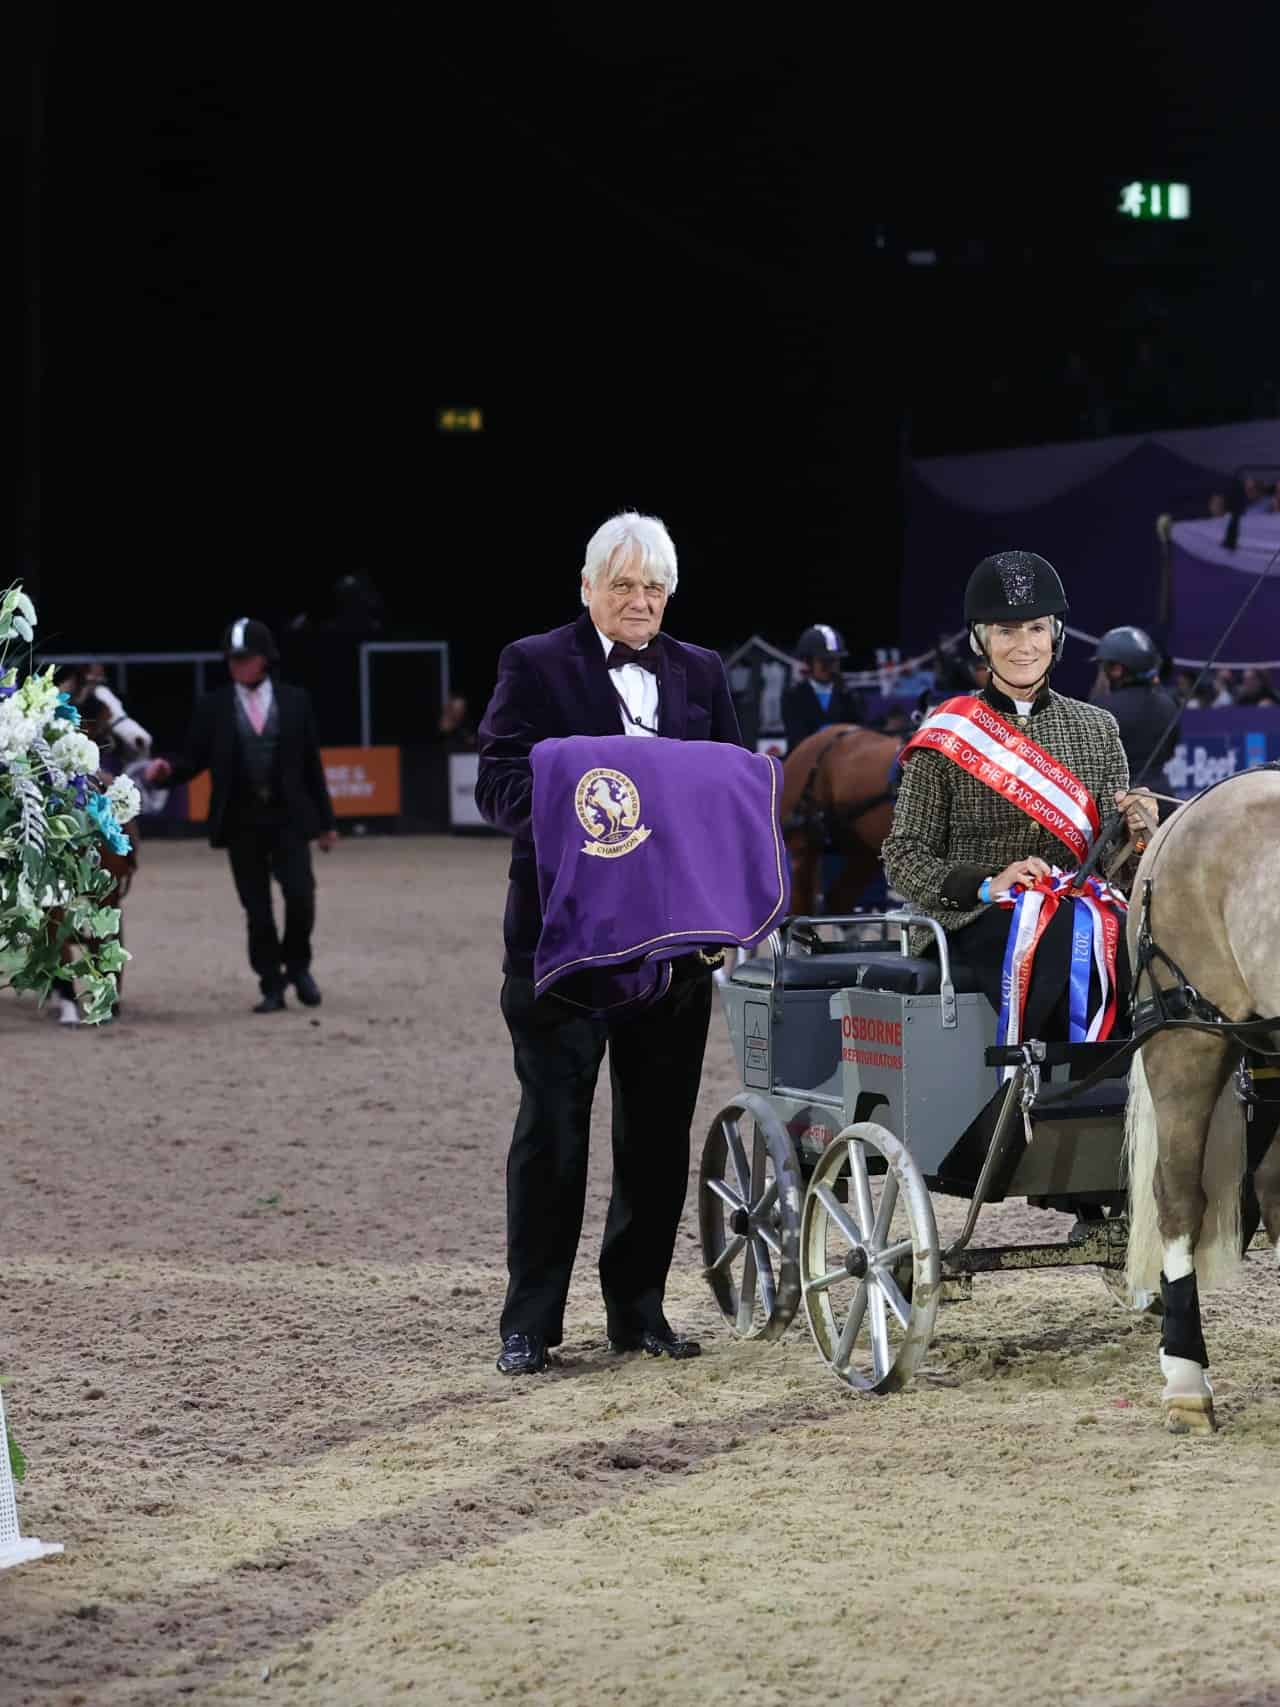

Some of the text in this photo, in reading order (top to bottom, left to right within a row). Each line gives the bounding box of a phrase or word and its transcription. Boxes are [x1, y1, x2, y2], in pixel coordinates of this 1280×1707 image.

[973, 708, 1088, 807] OSBORNE REFRIGERATORS
[927, 733, 963, 754] HORSE
[961, 749, 979, 764] OF
[979, 761, 1001, 783] THE
[1003, 776, 1033, 804] YEAR
[1031, 799, 1067, 829] SHOW
[596, 835, 640, 855] CHAMPION
[1073, 931, 1090, 962] 2021
[843, 1015, 902, 1047] OSBORNE
